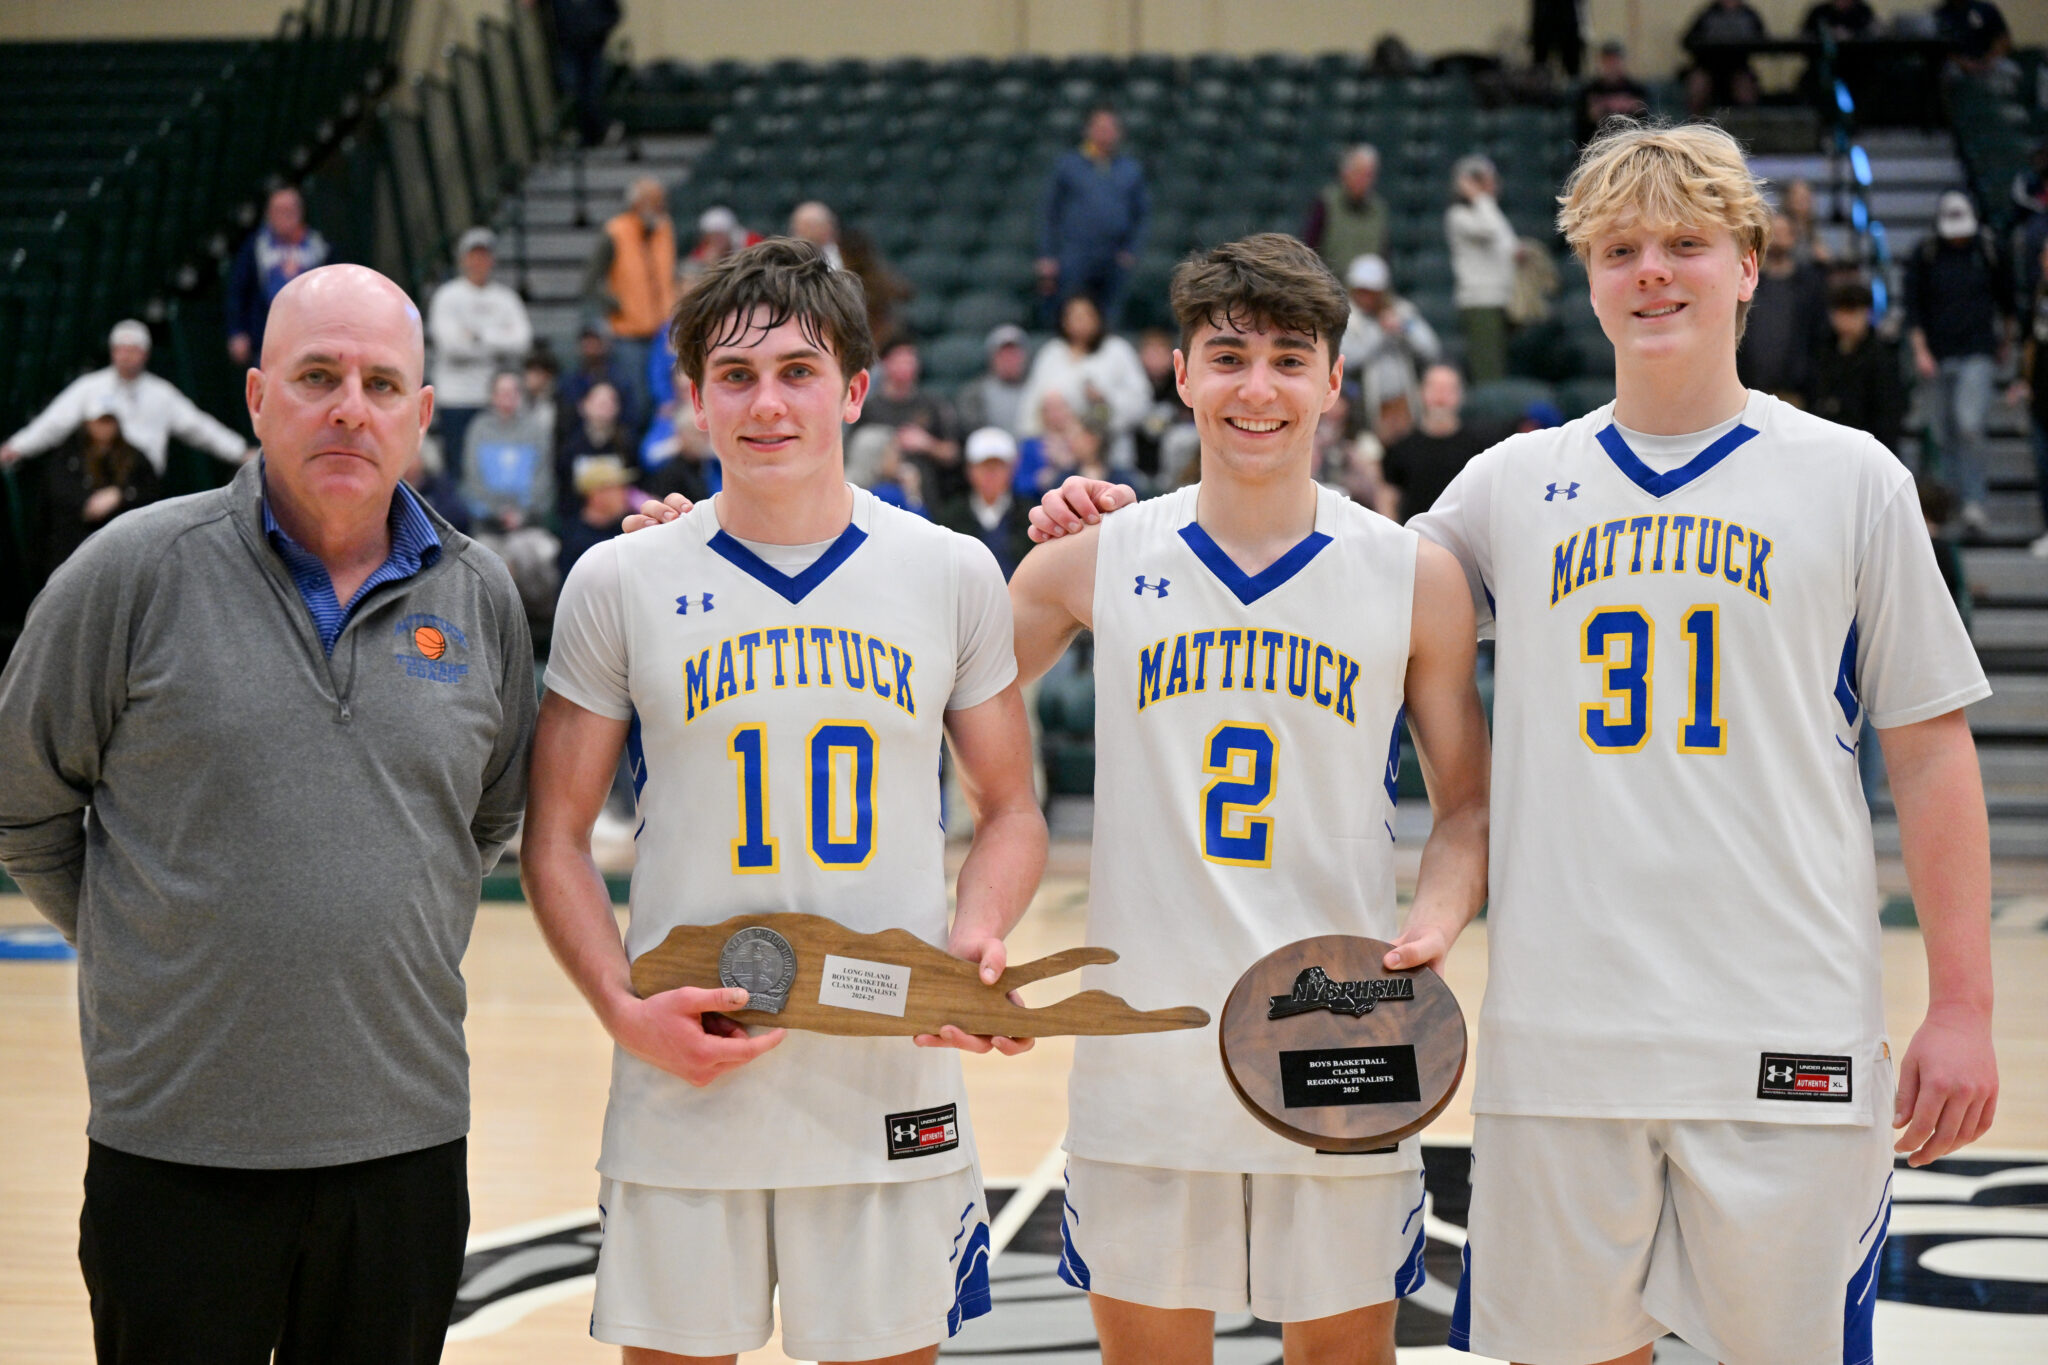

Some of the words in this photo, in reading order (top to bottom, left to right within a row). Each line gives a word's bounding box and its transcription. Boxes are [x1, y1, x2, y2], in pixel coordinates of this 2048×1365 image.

[1549, 514, 1774, 610] MATTITUCK
[395, 654, 468, 674] TUCKERS
[406, 665, 459, 683] COACH
[682, 625, 916, 727] MATTITUCK
[1137, 627, 1361, 728] MATTITUCK
[1579, 603, 1728, 756] 31
[726, 718, 880, 875] 10
[1199, 719, 1280, 869] 2
[843, 968, 863, 977] LONG
[864, 971, 890, 980] ISLAND
[831, 982, 854, 990] CLASS
[861, 986, 897, 997] FINALISTS
[853, 977, 898, 990] BASKETBALL
[1292, 978, 1413, 1001] NYSPHSAA
[852, 992, 875, 1000] 2024-25
[1309, 1060, 1332, 1068] BOYS
[1333, 1057, 1387, 1067] BASKETBALL
[1332, 1068, 1359, 1076] CLASS
[1307, 1077, 1350, 1086] REGIONAL
[1351, 1075, 1394, 1084] FINALISTS
[1797, 1079, 1828, 1088] AUTHENTIC
[1342, 1086, 1360, 1094] 2025
[921, 1131, 943, 1142] AUTHENTIC
